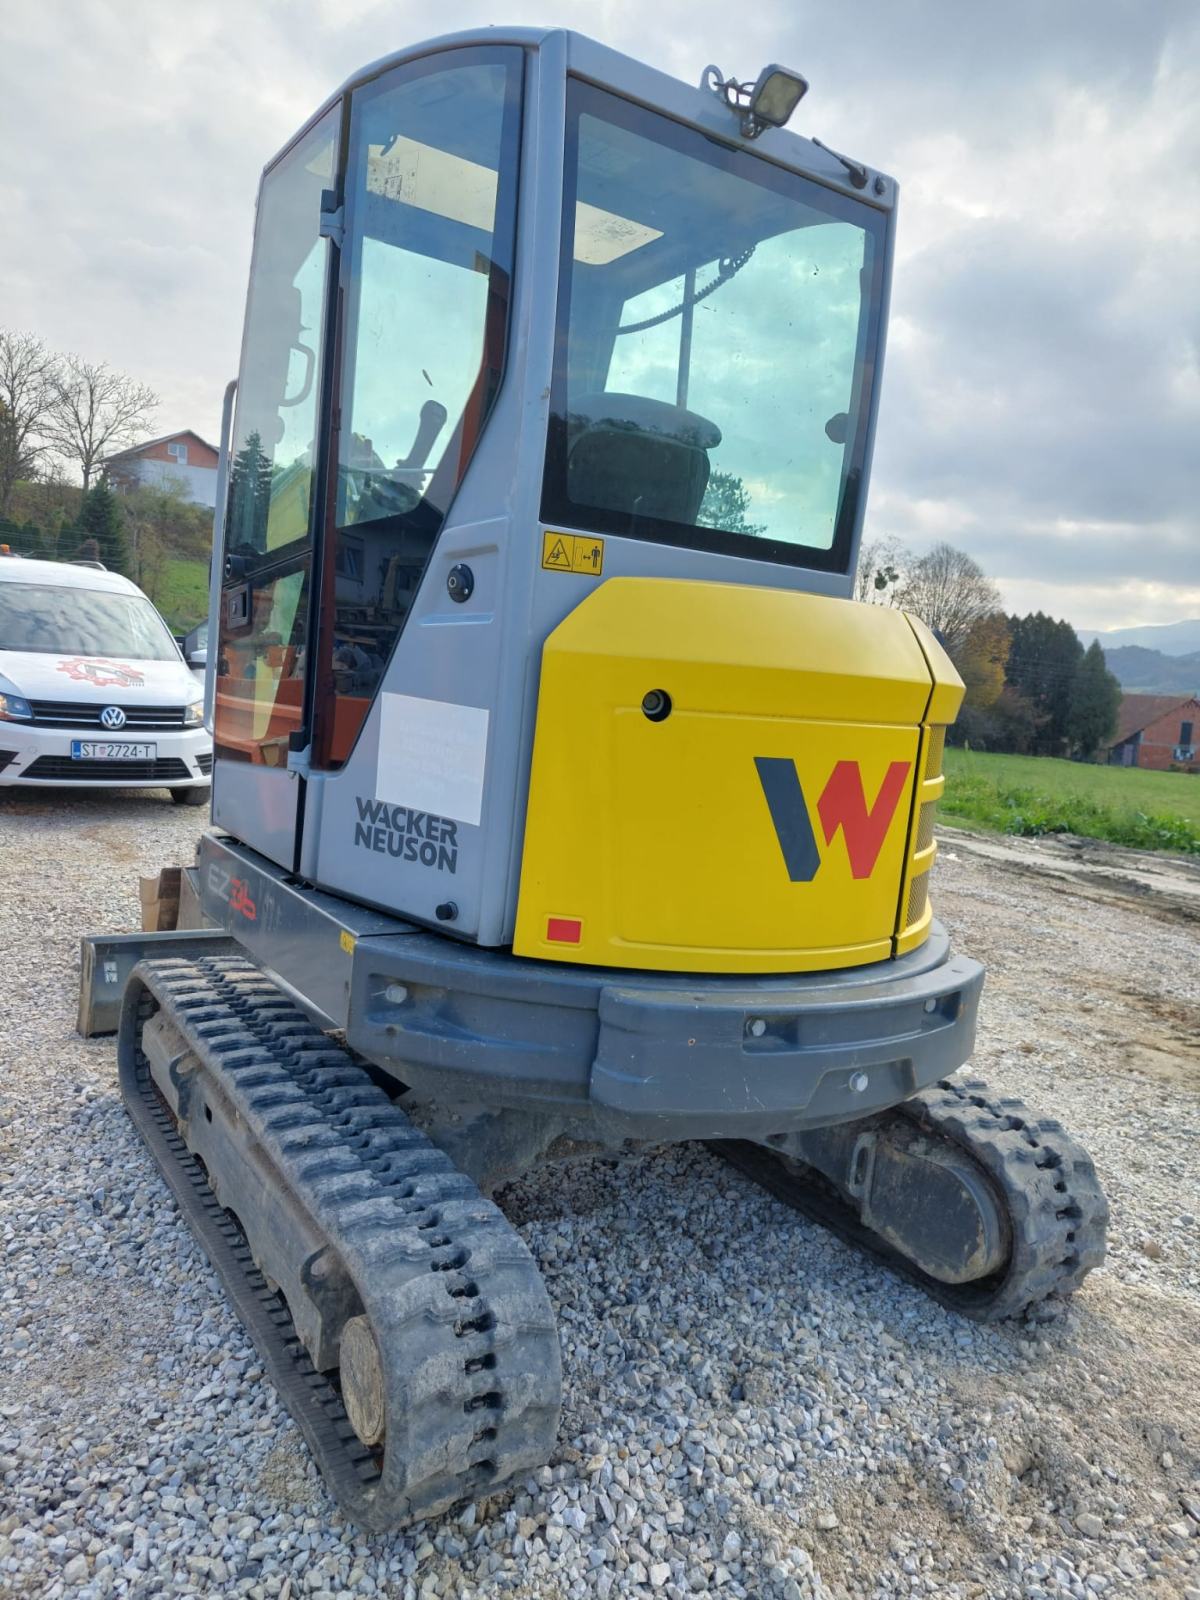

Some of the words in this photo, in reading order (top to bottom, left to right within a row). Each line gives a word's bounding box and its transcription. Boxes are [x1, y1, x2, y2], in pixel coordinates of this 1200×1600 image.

[82, 743, 98, 757] ST
[107, 744, 151, 757] 2724-T
[355, 796, 458, 847] WACKER
[354, 822, 458, 874] NEUSON
